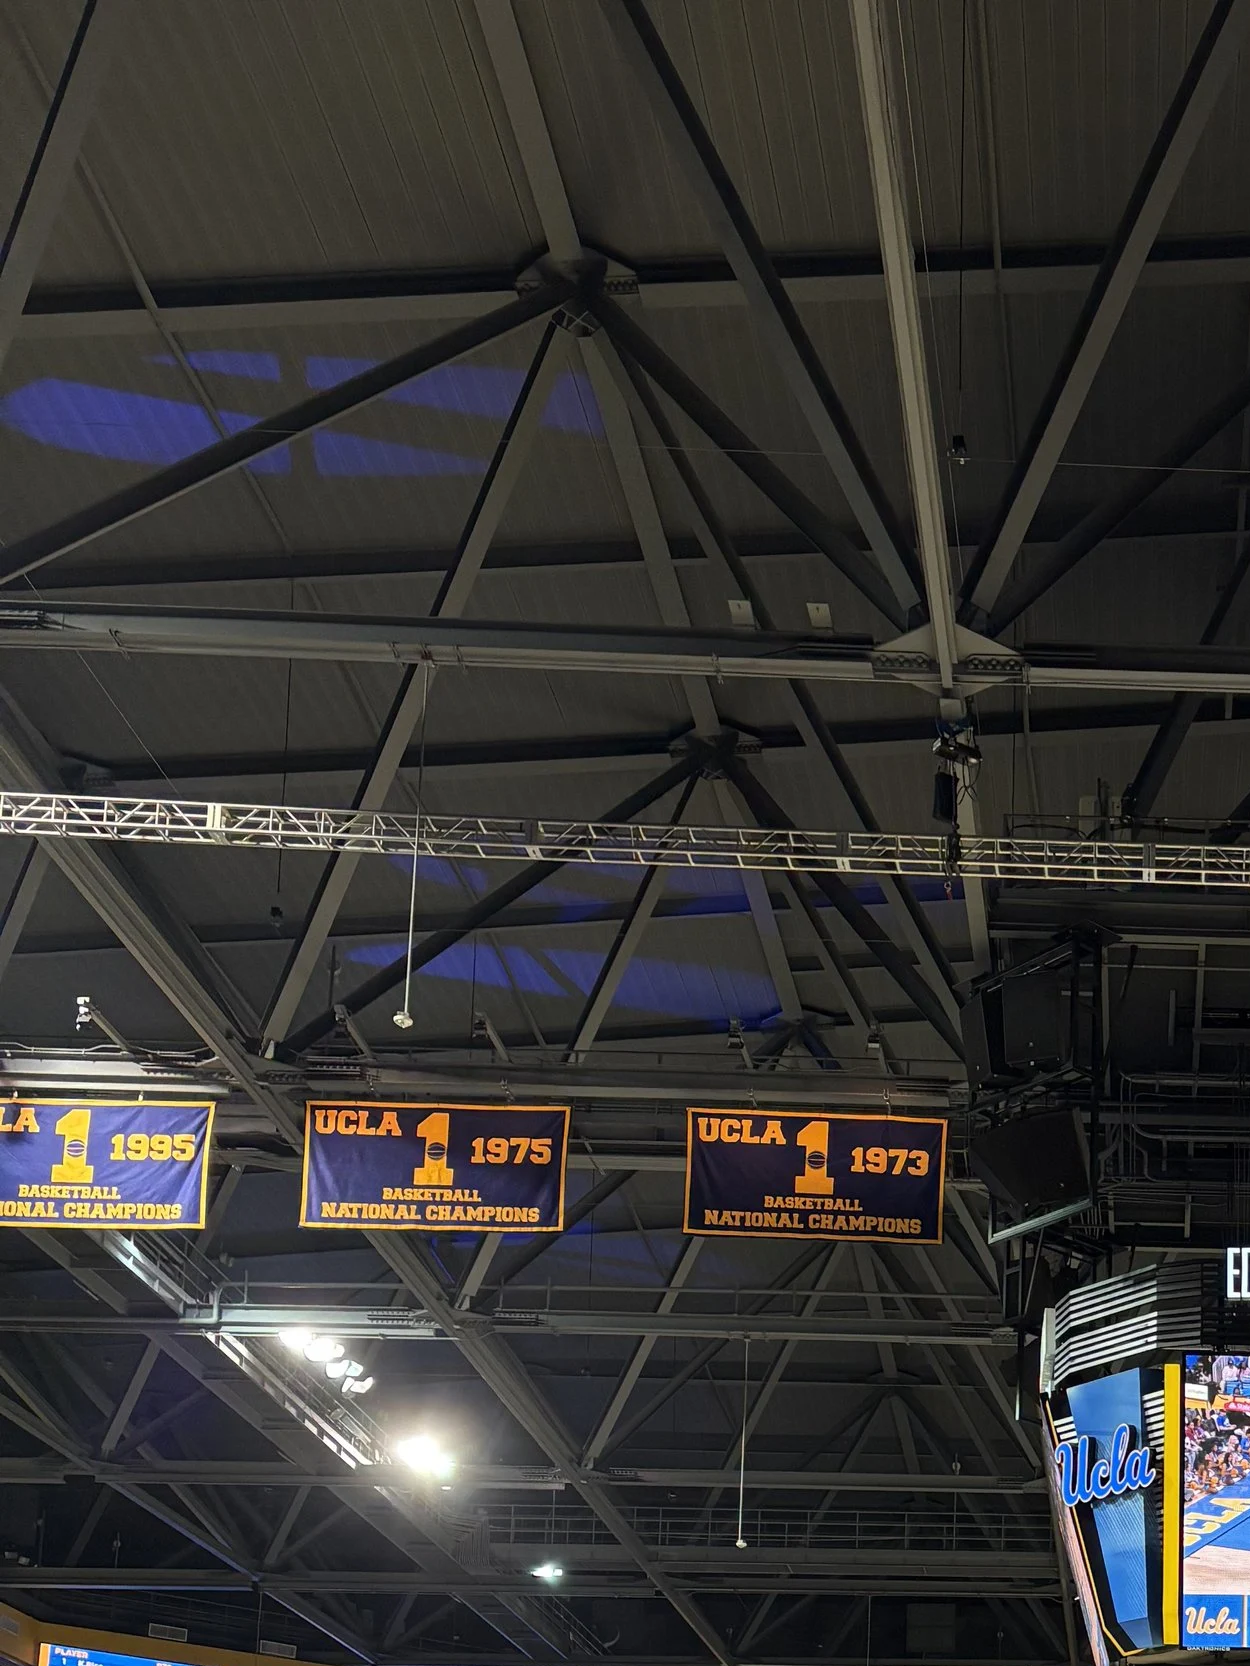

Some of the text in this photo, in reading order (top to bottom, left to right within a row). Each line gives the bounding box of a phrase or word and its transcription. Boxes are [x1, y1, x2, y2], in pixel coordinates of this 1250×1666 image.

[0, 1107, 40, 1133] LA
[314, 1109, 402, 1136] UCLA
[697, 1117, 786, 1145] UCLA
[51, 1108, 94, 1184] 1
[110, 1134, 196, 1161] 1995
[412, 1112, 454, 1186] 1
[470, 1137, 552, 1165] 1975
[795, 1120, 834, 1195] 1
[850, 1147, 930, 1177] 1973
[18, 1184, 121, 1200] BASKETBALL
[382, 1187, 481, 1202] BASKETBALL
[763, 1195, 863, 1212] BASKETBALL
[63, 1202, 182, 1220] CHAMPIONS
[321, 1202, 540, 1223] NATIONAL CHAMPIONS
[704, 1210, 922, 1235] NATIONAL CHAMPIONS
[1055, 1423, 1157, 1507] Ucla
[1185, 1606, 1241, 1635] Ucla
